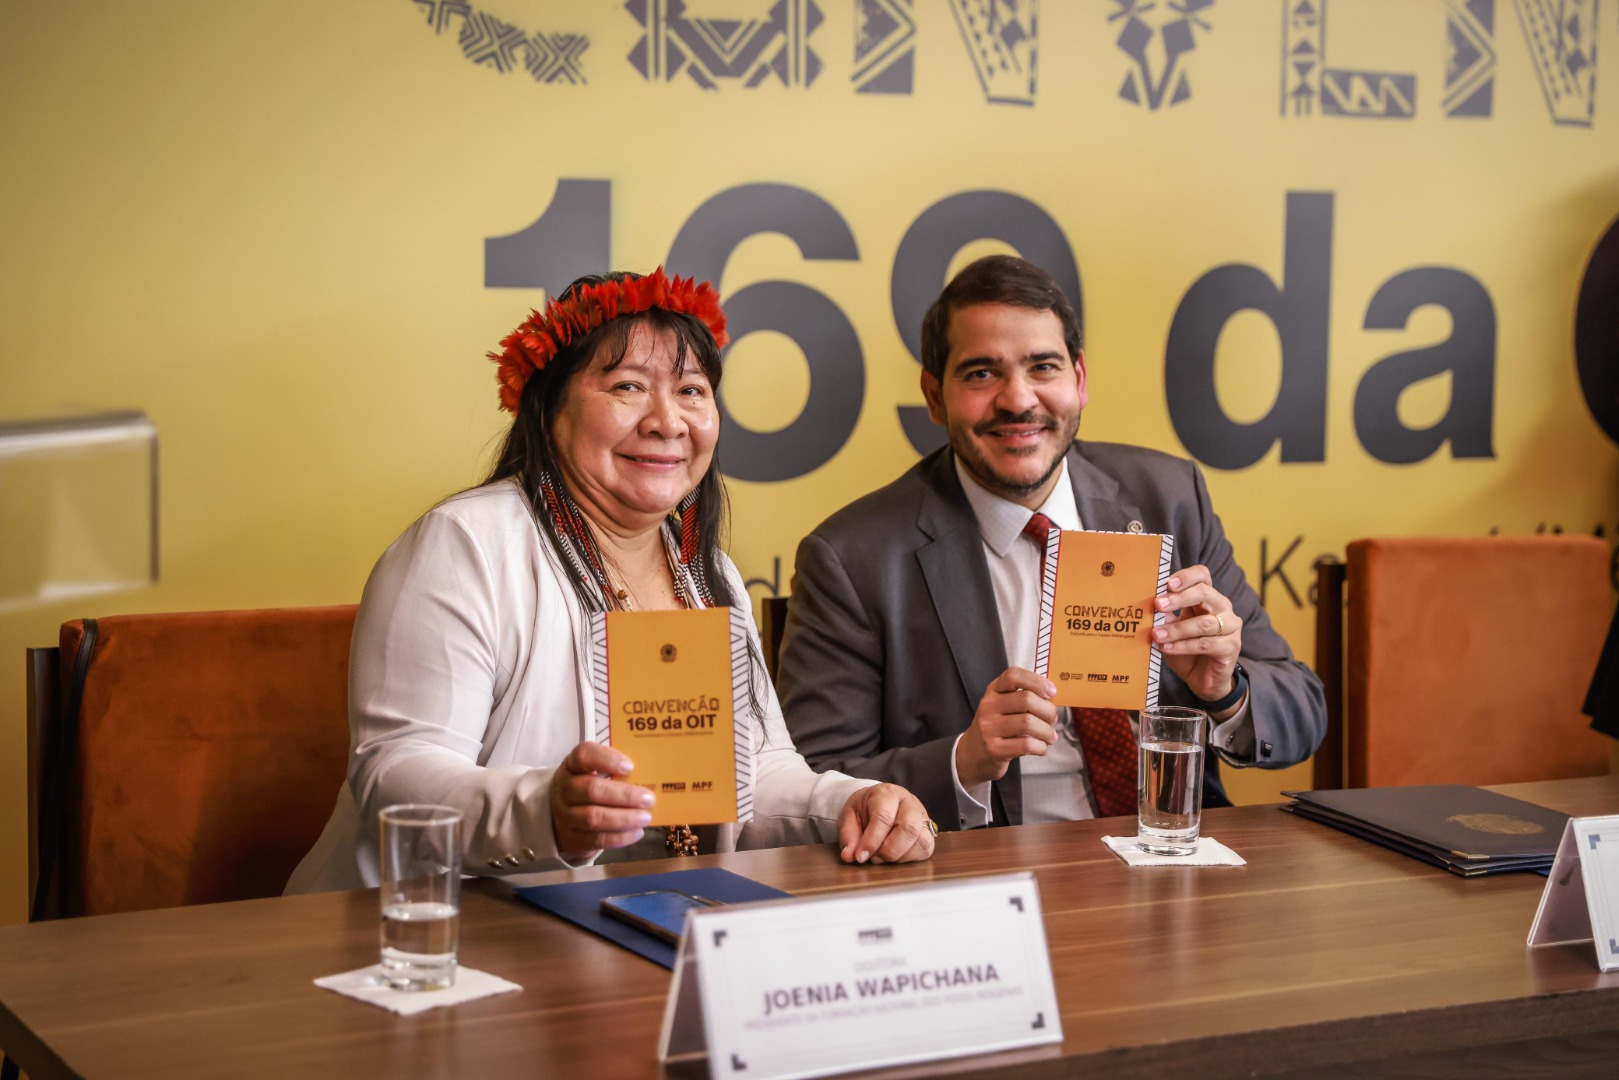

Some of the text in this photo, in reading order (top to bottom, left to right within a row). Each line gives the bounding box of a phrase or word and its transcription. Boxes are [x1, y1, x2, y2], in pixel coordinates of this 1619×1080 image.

[1164, 190, 1497, 471] da
[1064, 605, 1144, 619] CONVENÇÃO
[1066, 618, 1140, 633] 169 da OIT
[1112, 674, 1130, 682] MPF
[623, 695, 720, 714] CONVENÇÃO
[627, 714, 717, 731] 169 da OIT
[692, 781, 713, 789] MPF
[762, 964, 1000, 1015] JOENIA WAPICHANA
